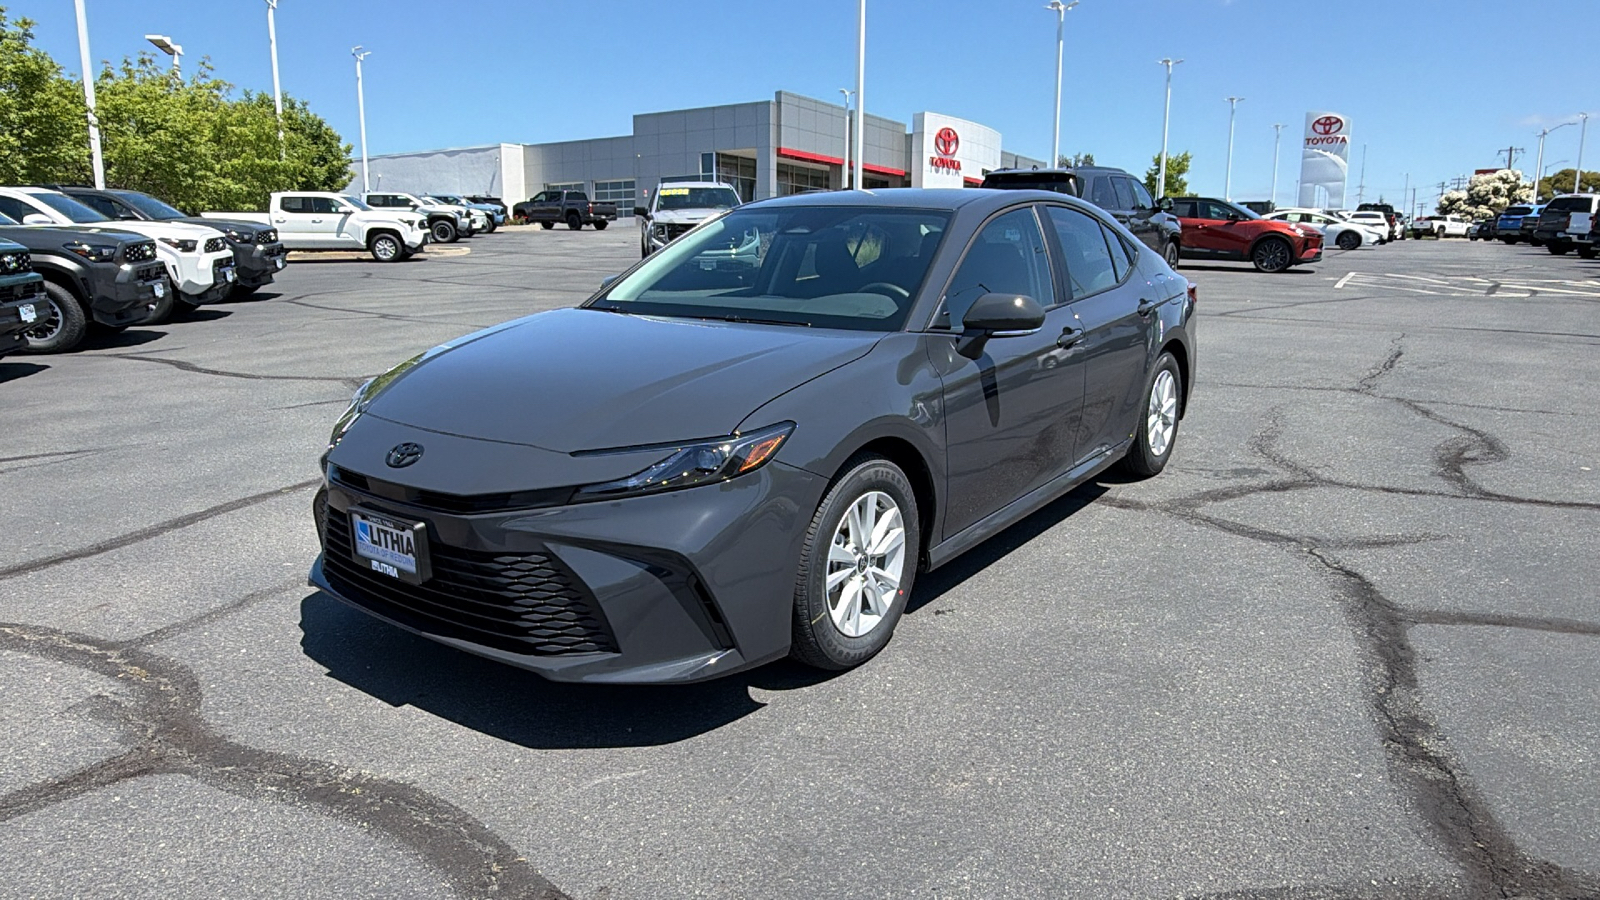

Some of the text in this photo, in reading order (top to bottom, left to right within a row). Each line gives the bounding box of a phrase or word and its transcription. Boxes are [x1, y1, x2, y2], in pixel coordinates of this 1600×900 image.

[1305, 136, 1348, 146] TOYOTA
[929, 156, 962, 171] TOYOTA
[359, 541, 380, 556] TOYOTA
[381, 548, 389, 558] OF
[368, 524, 416, 558] LITHIA
[377, 561, 399, 579] LITHIA
